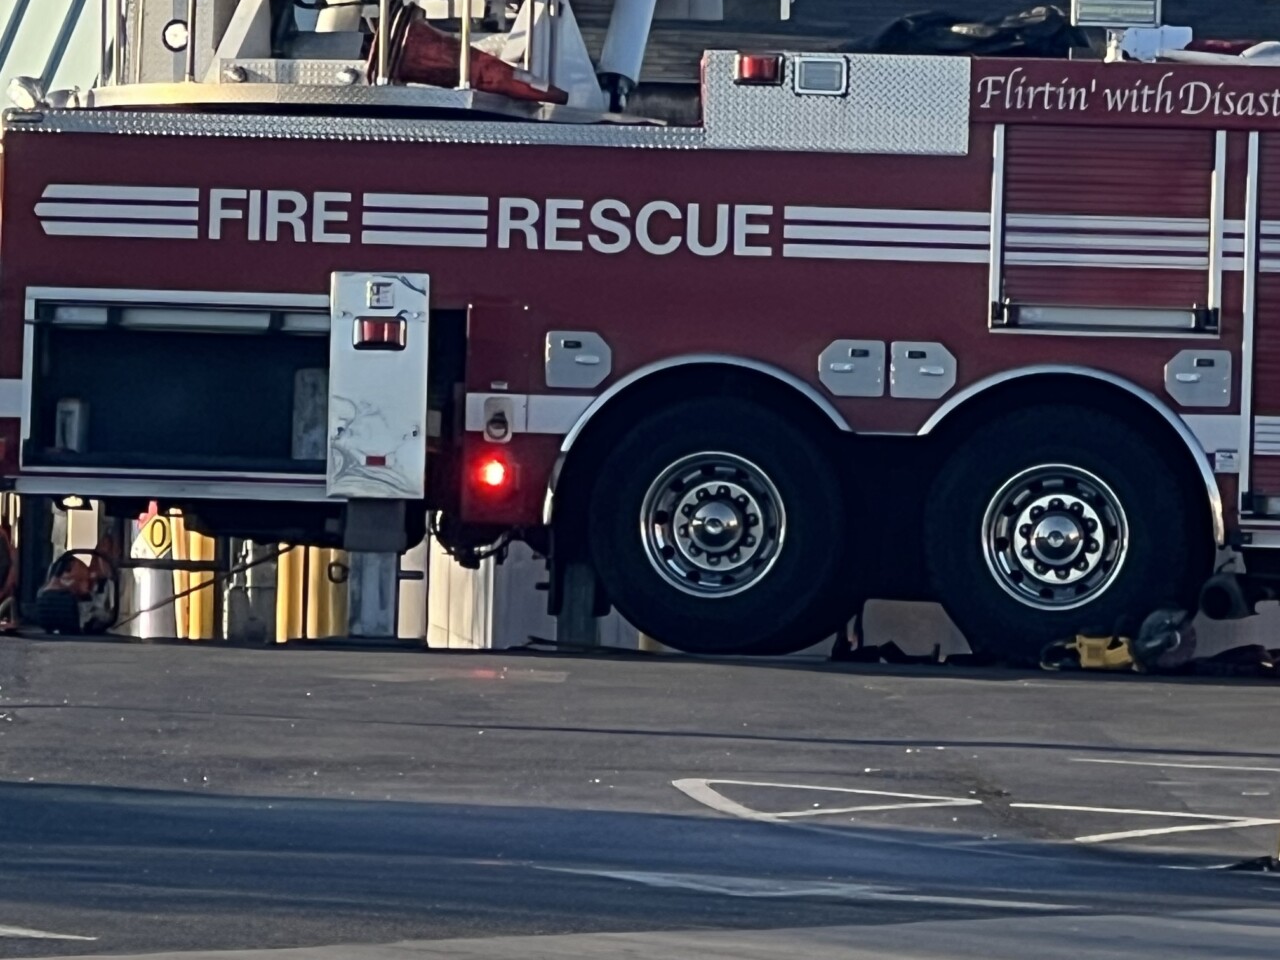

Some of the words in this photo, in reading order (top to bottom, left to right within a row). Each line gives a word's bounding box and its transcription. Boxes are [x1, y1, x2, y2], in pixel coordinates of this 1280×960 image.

[977, 67, 1097, 111] Flirtin'
[1103, 72, 1182, 114] with
[208, 188, 352, 243] FIRE
[497, 196, 774, 256] RESCUE
